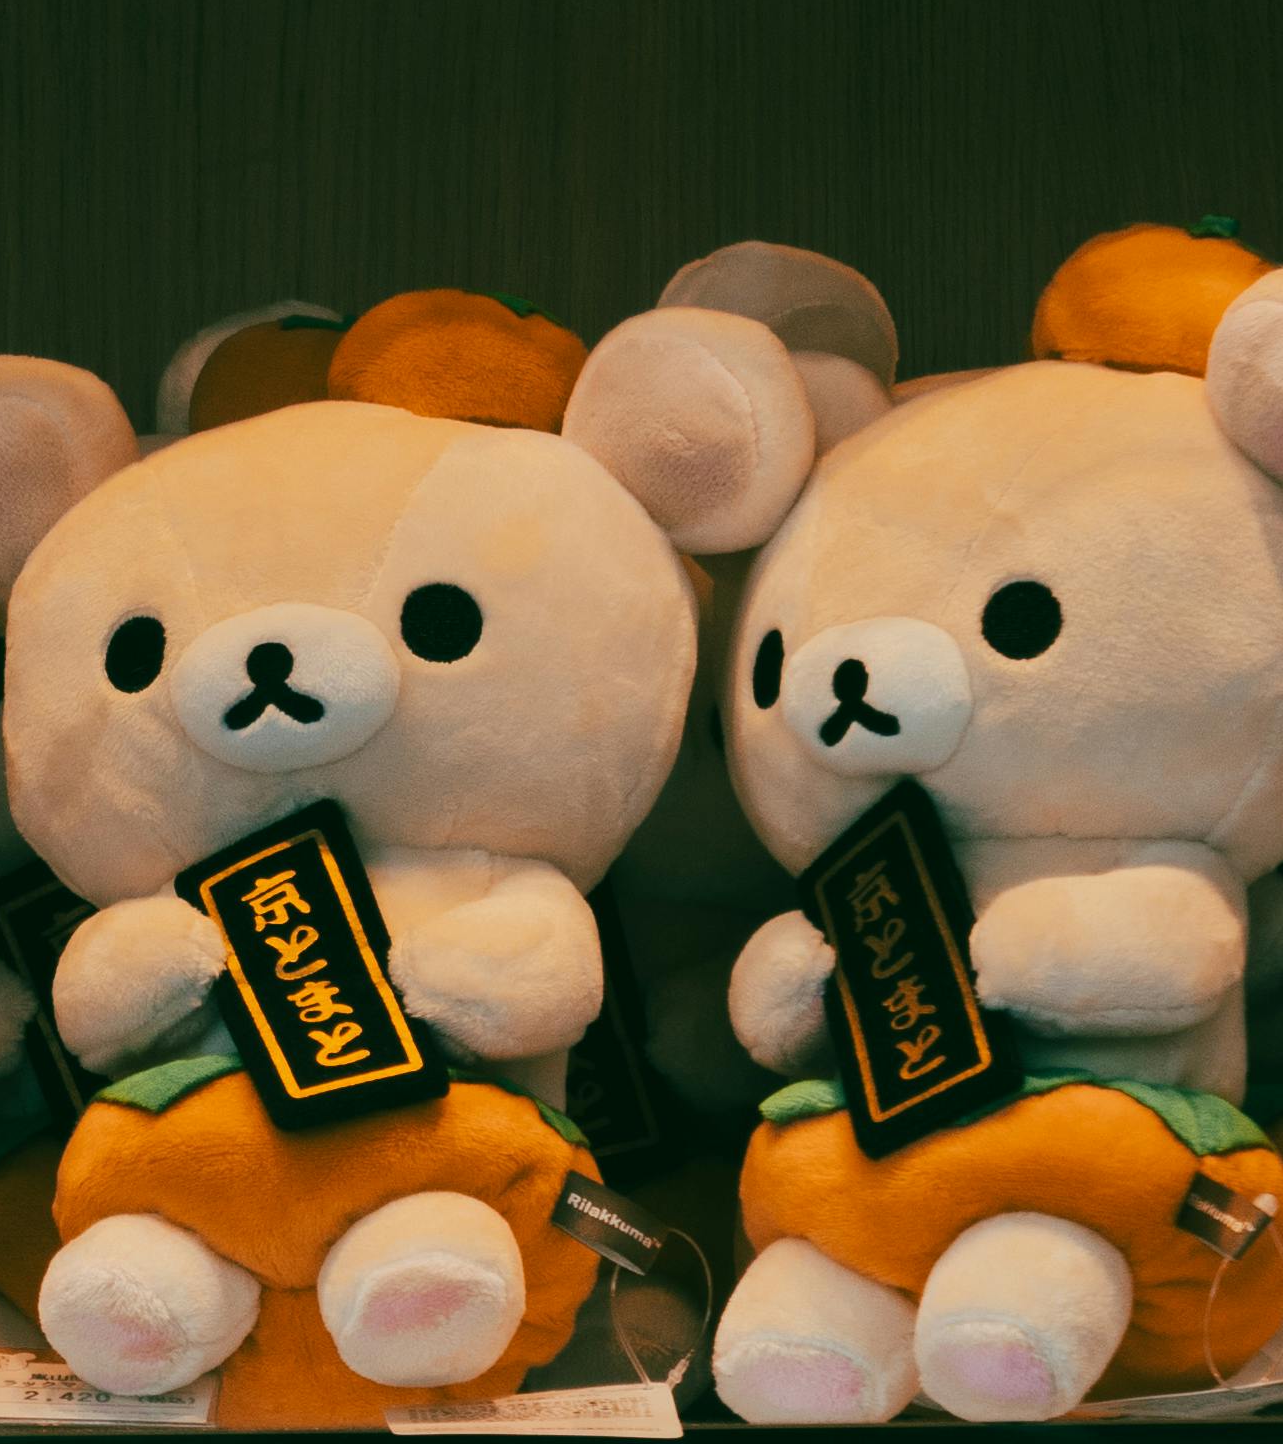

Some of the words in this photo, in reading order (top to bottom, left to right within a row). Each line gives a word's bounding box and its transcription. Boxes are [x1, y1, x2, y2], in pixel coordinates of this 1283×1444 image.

[240, 867, 372, 1069] 京とまと
[846, 859, 945, 1081] 京とまと
